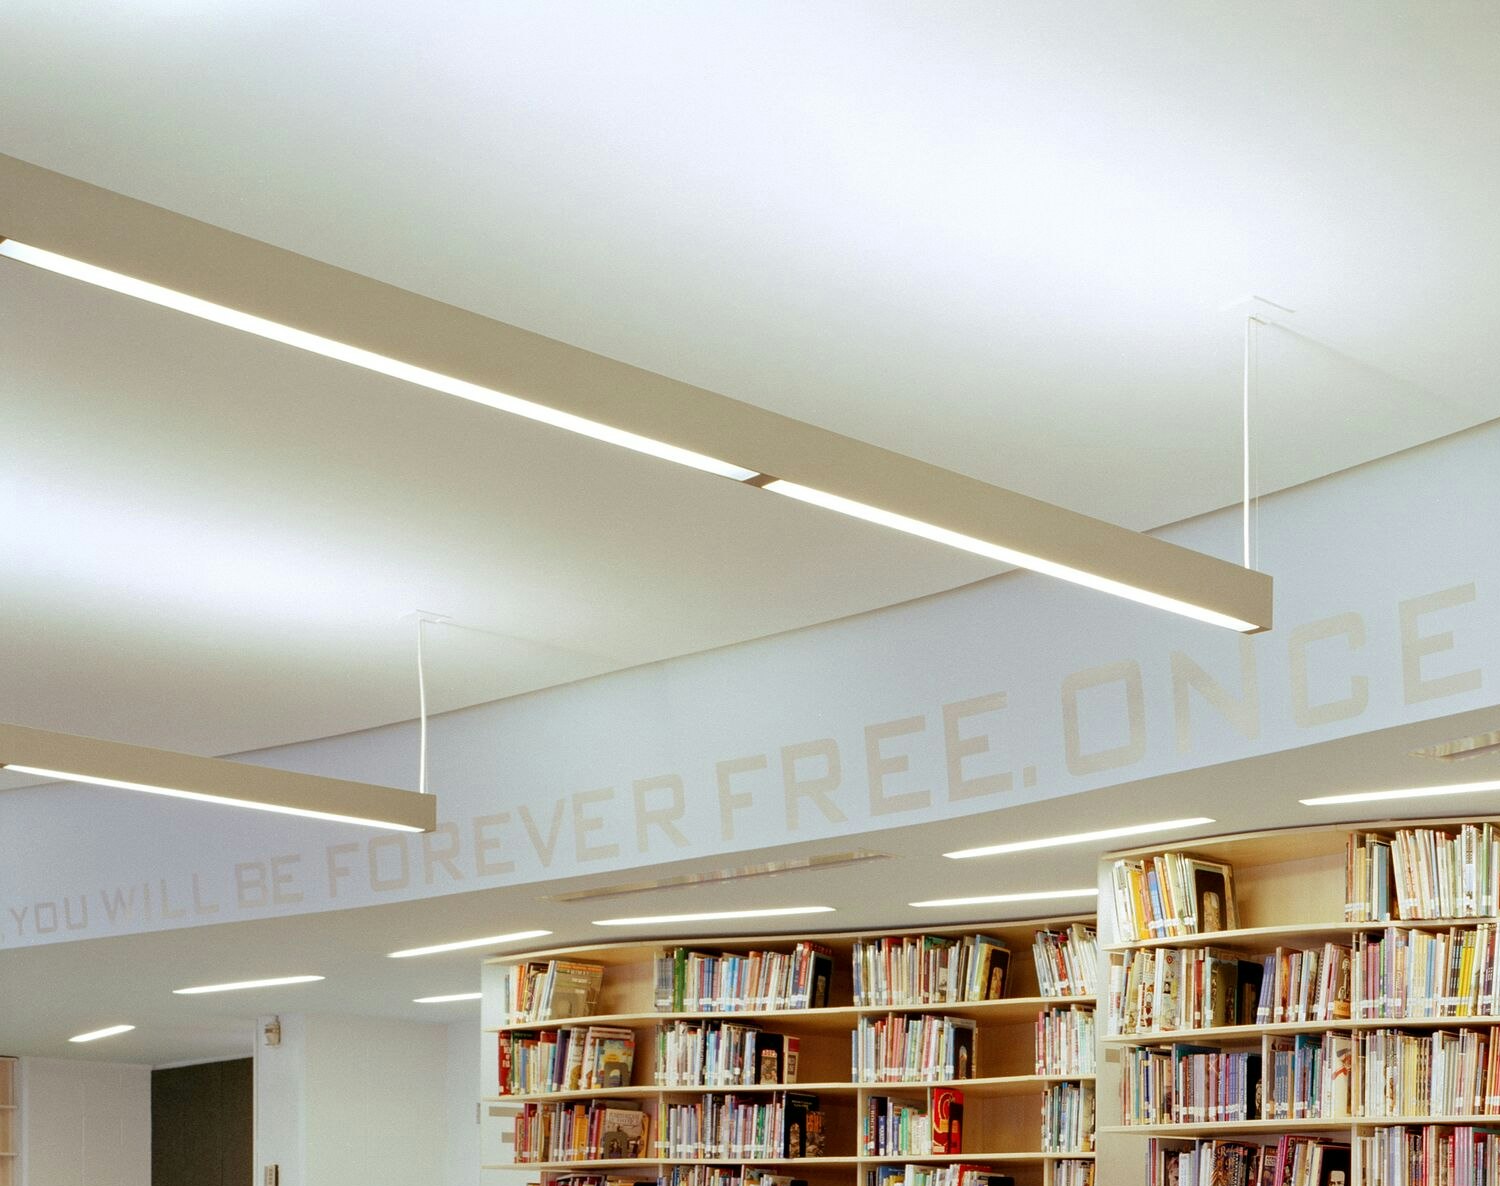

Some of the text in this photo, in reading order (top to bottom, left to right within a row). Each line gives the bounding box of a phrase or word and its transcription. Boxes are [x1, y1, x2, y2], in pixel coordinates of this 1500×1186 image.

[10, 895, 88, 936] YOU
[101, 872, 220, 922] WILL
[235, 854, 304, 909] BE
[326, 773, 690, 898] FOREVER
[714, 691, 1036, 842] FREE.
[1060, 582, 1483, 778] ONCE
